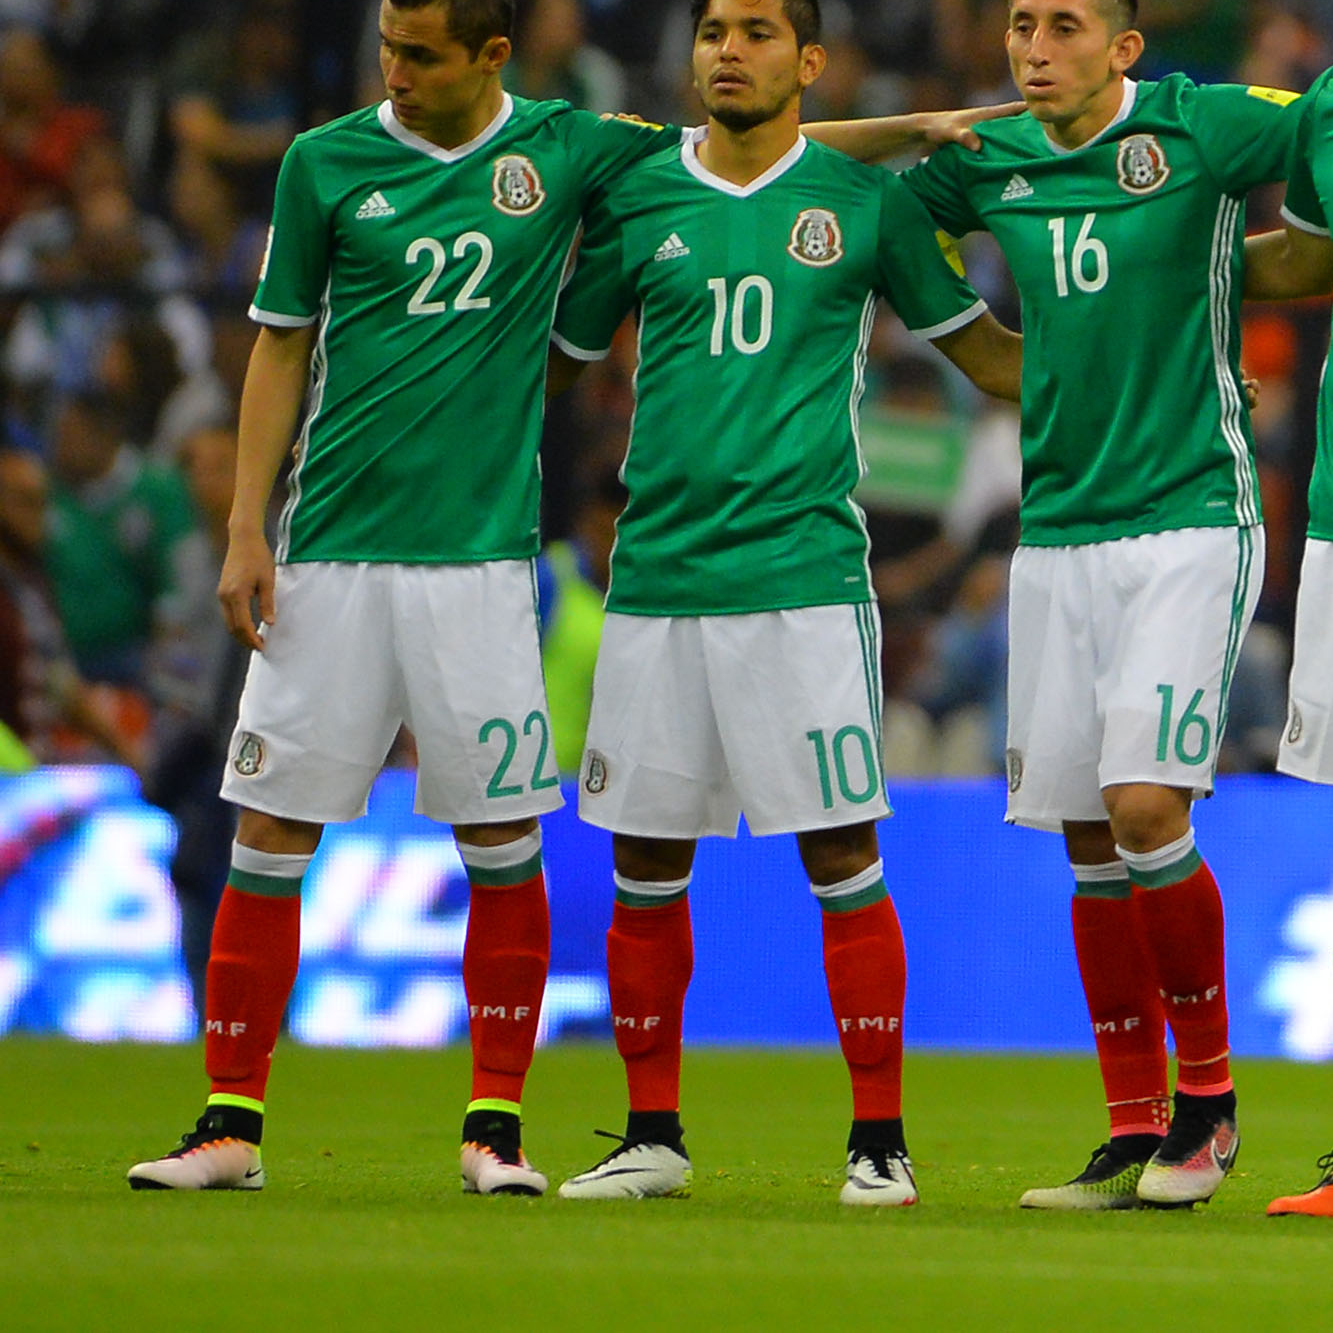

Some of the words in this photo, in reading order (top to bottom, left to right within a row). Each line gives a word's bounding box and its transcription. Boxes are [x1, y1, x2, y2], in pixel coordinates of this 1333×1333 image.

[405, 230, 494, 316] 22
[1047, 212, 1109, 298] 16
[706, 274, 775, 357] 10
[477, 710, 560, 799] 22
[806, 724, 879, 810] 10
[1155, 683, 1211, 767] 16
